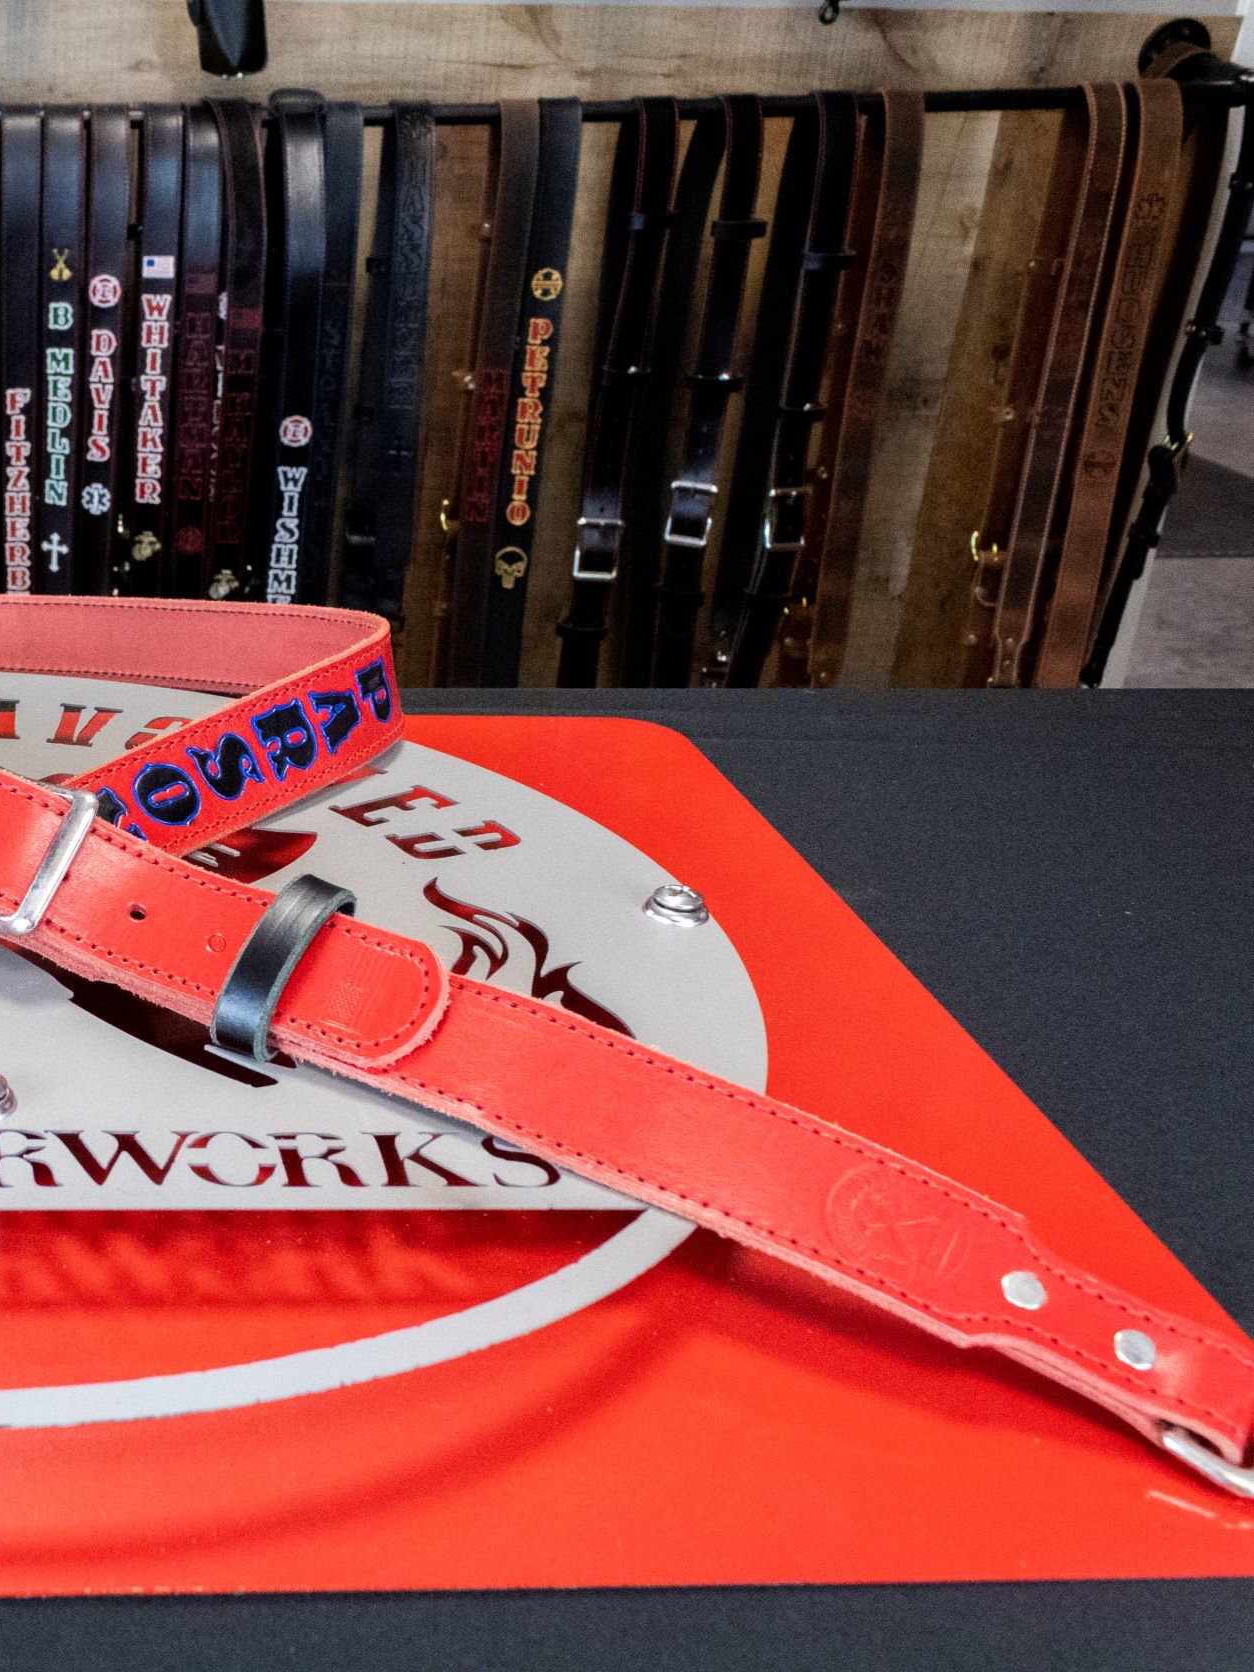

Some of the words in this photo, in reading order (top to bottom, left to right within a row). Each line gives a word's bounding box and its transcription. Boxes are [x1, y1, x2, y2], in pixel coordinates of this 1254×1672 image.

[48, 301, 74, 331] B
[45, 348, 74, 506] MEDLIN
[87, 329, 117, 462] DAVIS
[135, 294, 172, 504] WHITAKER
[217, 391, 252, 545] TAYLOR
[465, 367, 510, 523] MARTIN
[506, 317, 554, 526] PETRUNIO
[5, 388, 31, 595] FITZHERB
